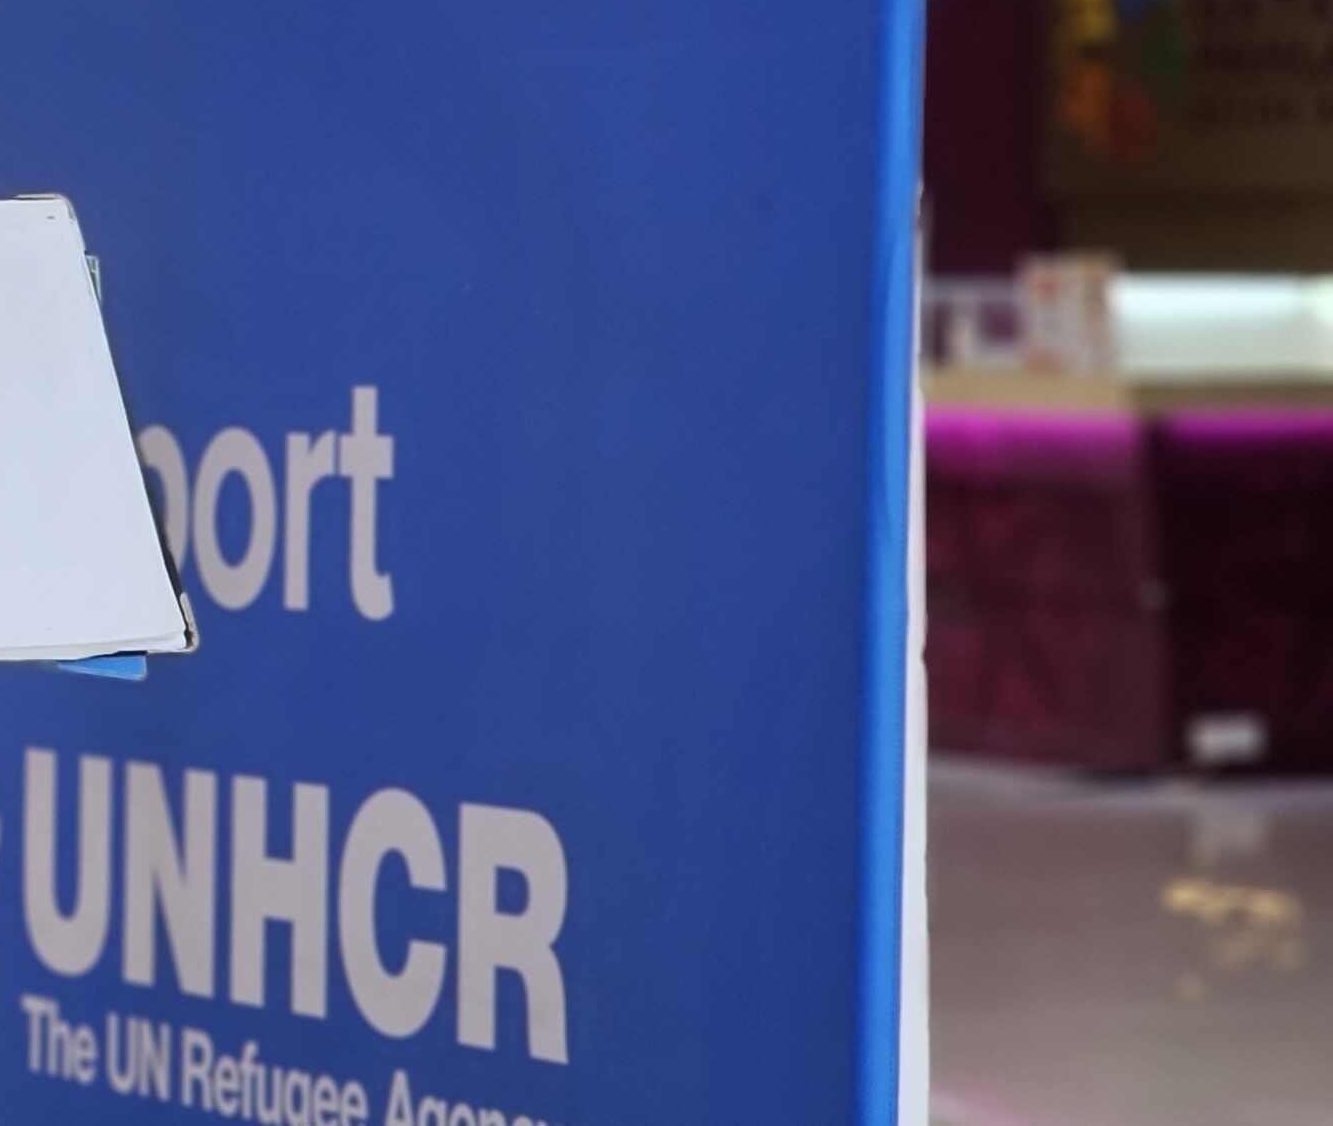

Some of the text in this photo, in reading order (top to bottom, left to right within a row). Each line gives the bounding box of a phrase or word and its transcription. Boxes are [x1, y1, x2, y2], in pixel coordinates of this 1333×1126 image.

[23, 746, 569, 1065] UNHCR
[20, 993, 97, 1086] The
[105, 1012, 170, 1102] UN
[181, 1025, 369, 1126] Refugee
